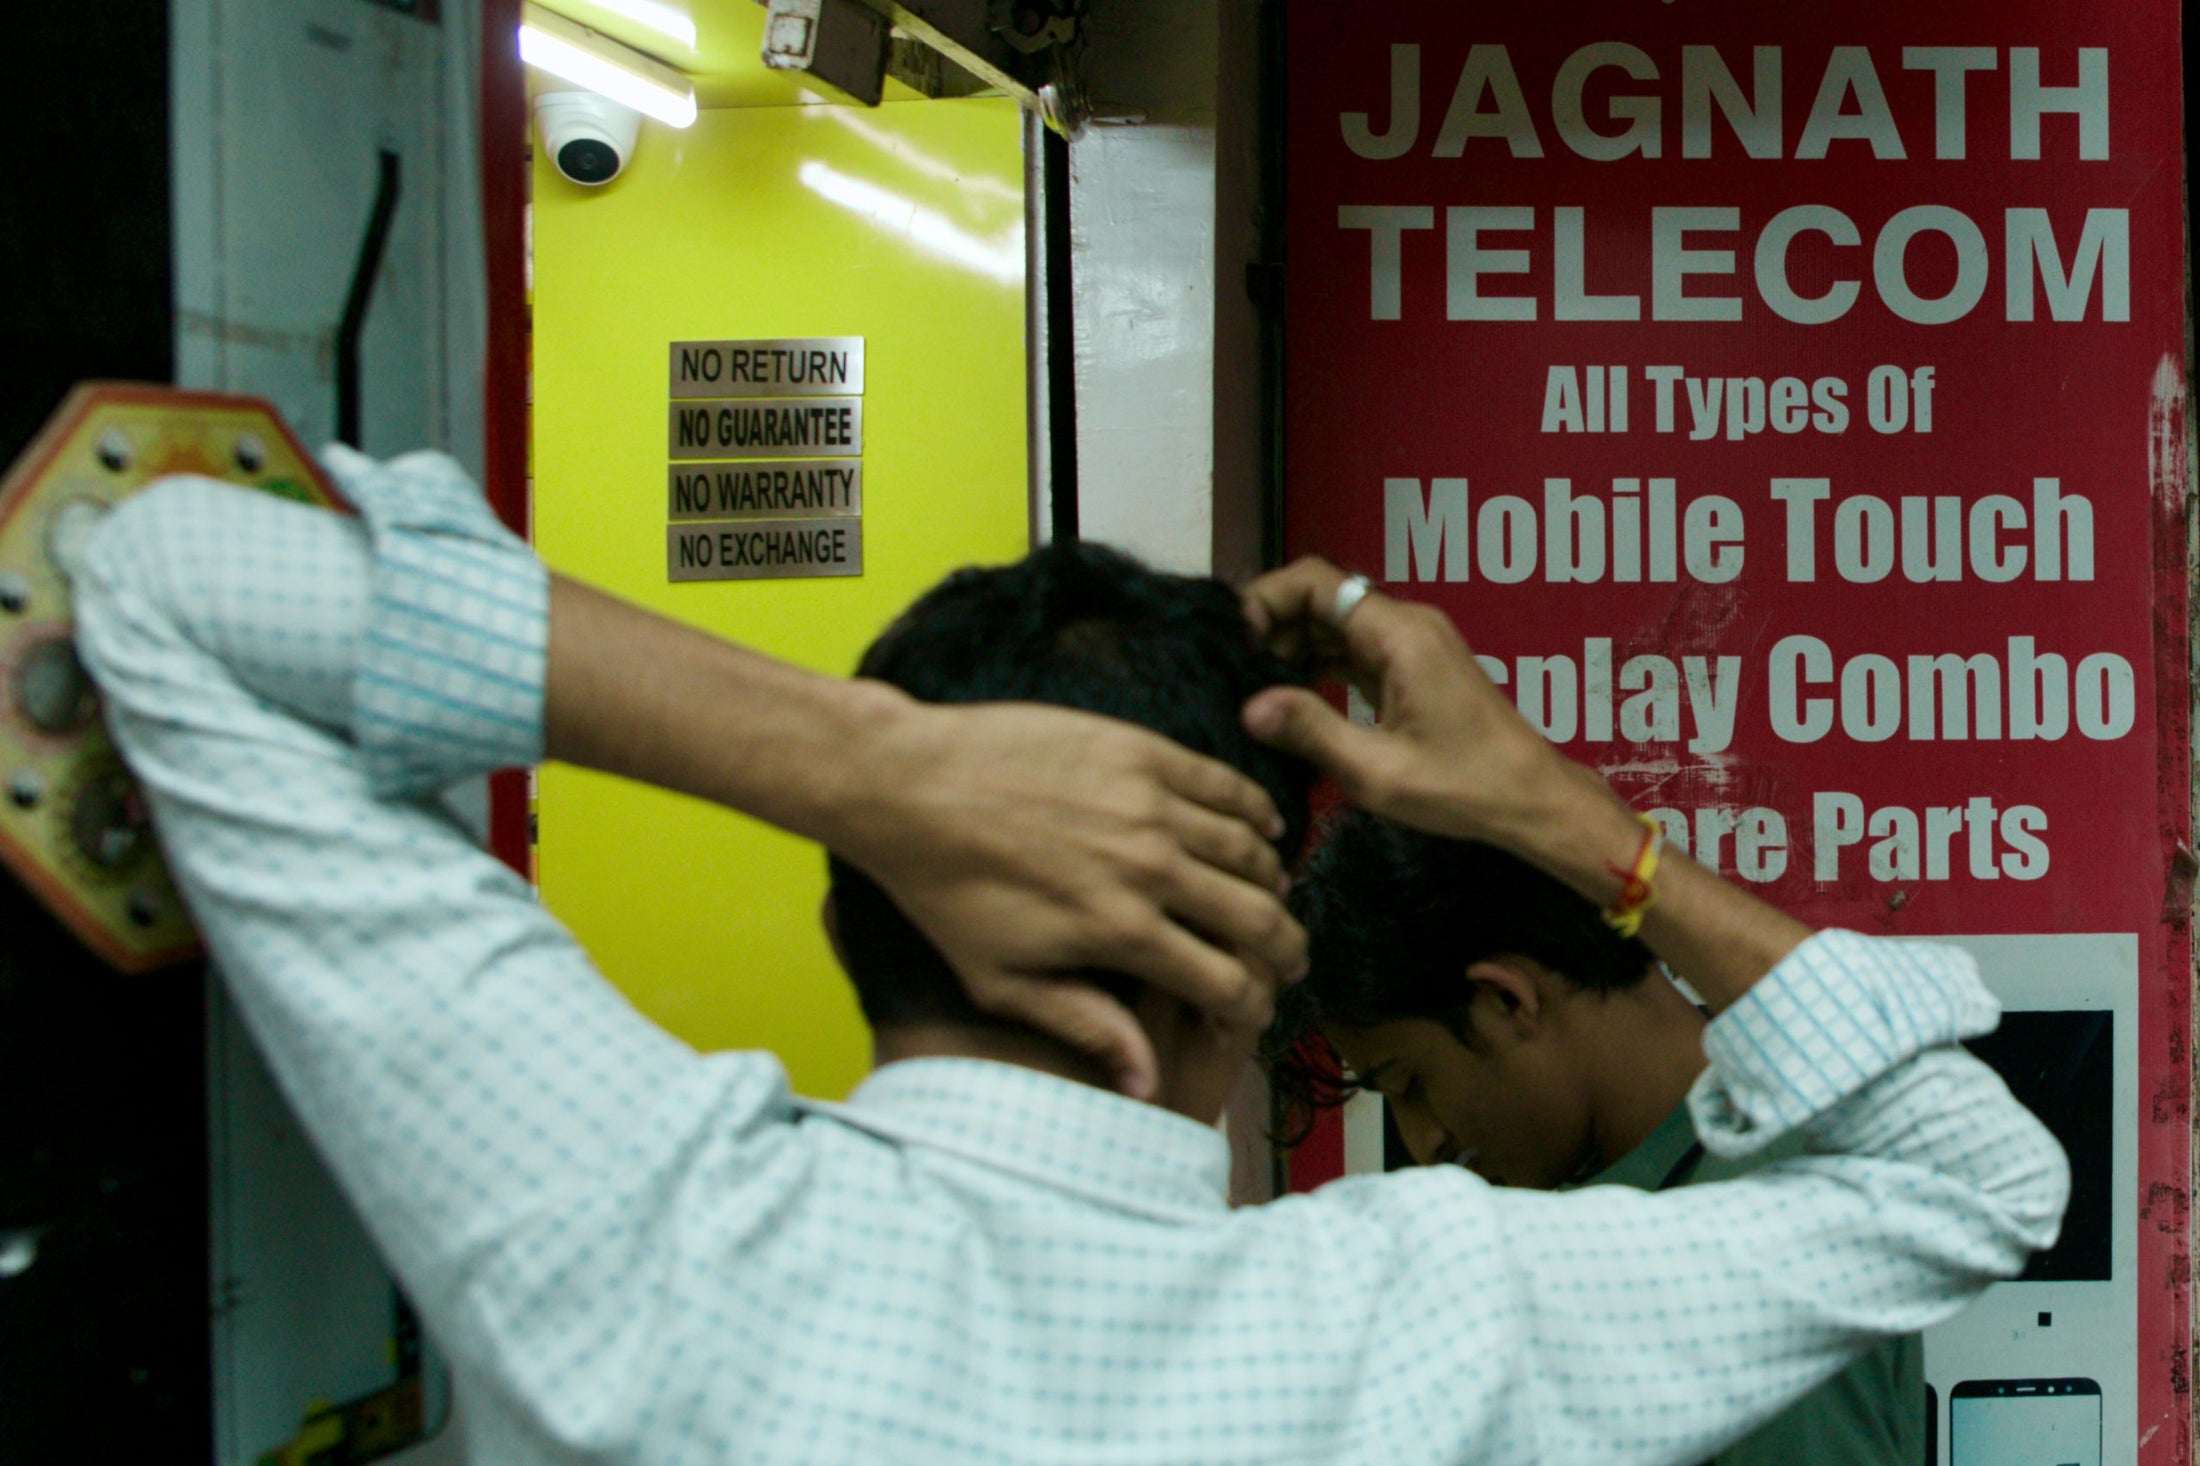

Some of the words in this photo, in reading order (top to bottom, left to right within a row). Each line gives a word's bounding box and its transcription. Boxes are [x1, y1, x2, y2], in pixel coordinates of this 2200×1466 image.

[1340, 42, 2109, 161] JAGNATH
[1339, 204, 2130, 325] TELECOM
[681, 349, 722, 382] NO
[732, 349, 847, 384] RETURN
[1541, 365, 1628, 433] All
[1646, 365, 1849, 441] Types
[1867, 365, 1935, 434] Of
[680, 409, 710, 447] NO
[718, 408, 852, 447] GUARANTEE
[676, 474, 710, 513] NO
[717, 469, 855, 512] WARRANTY
[1384, 477, 1744, 584] Mobile
[1771, 477, 2094, 583] Touch
[680, 534, 713, 568] NO
[720, 529, 846, 567] EXCHANGE
[1347, 637, 1741, 754] play
[1768, 634, 2136, 743] Combo
[1813, 791, 2050, 882] Parts
